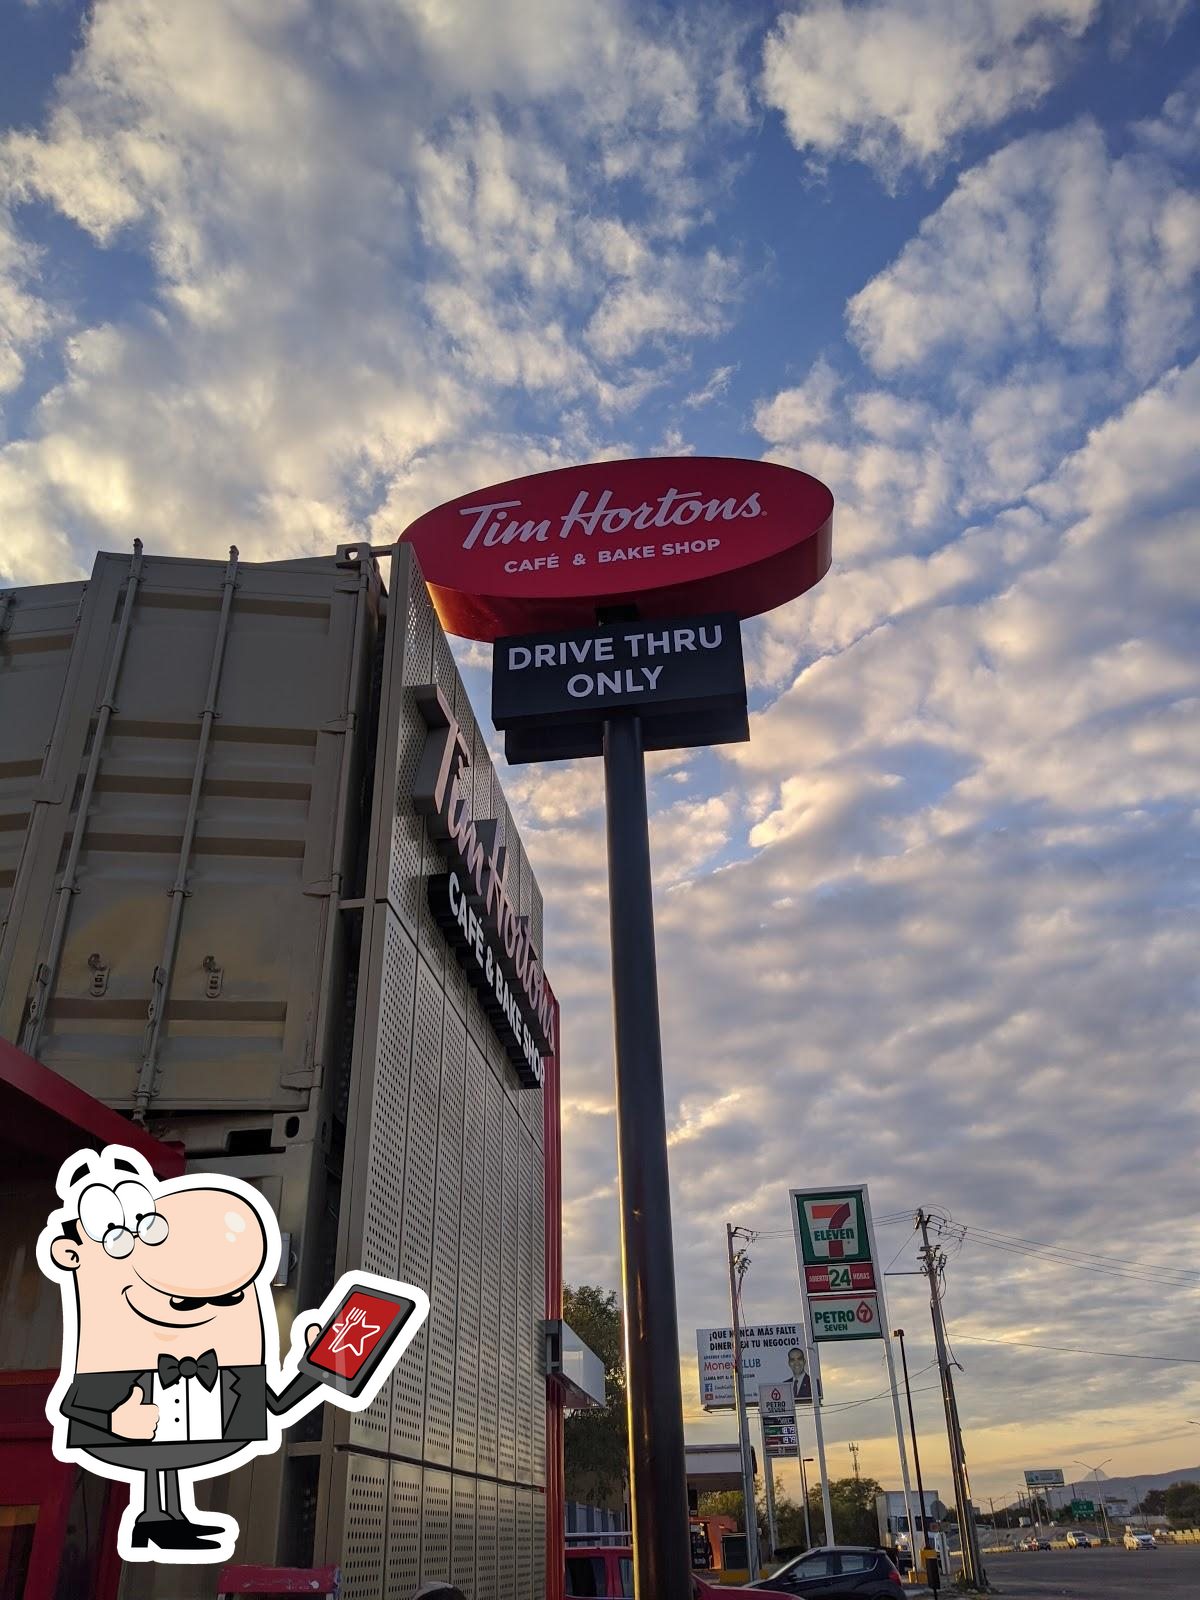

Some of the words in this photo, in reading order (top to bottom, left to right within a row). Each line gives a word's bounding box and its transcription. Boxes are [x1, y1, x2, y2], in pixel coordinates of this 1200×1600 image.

[459, 500, 551, 551] Tim
[559, 487, 762, 538] Hortons
[503, 553, 560, 574] CAFÉ
[573, 552, 587, 566] &
[598, 545, 656, 564] BAKE
[661, 538, 721, 557] SHOP
[508, 637, 614, 671] DRIVE
[624, 624, 723, 658] THRU
[567, 665, 665, 698] ONLY
[434, 684, 484, 896] Tim
[448, 871, 485, 969] CAFÉ
[484, 955, 494, 987] &
[495, 962, 522, 1046] BAKE
[829, 1268, 851, 1287] 24
[729, 1328, 755, 1339] NNCA
[757, 1326, 774, 1337] MÁS
[776, 1326, 797, 1335] FALTE
[814, 1310, 855, 1324] PETRO
[824, 1324, 848, 1332] SEVEN
[751, 1338, 761, 1347] TU
[763, 1336, 800, 1347] NEGOCIO!
